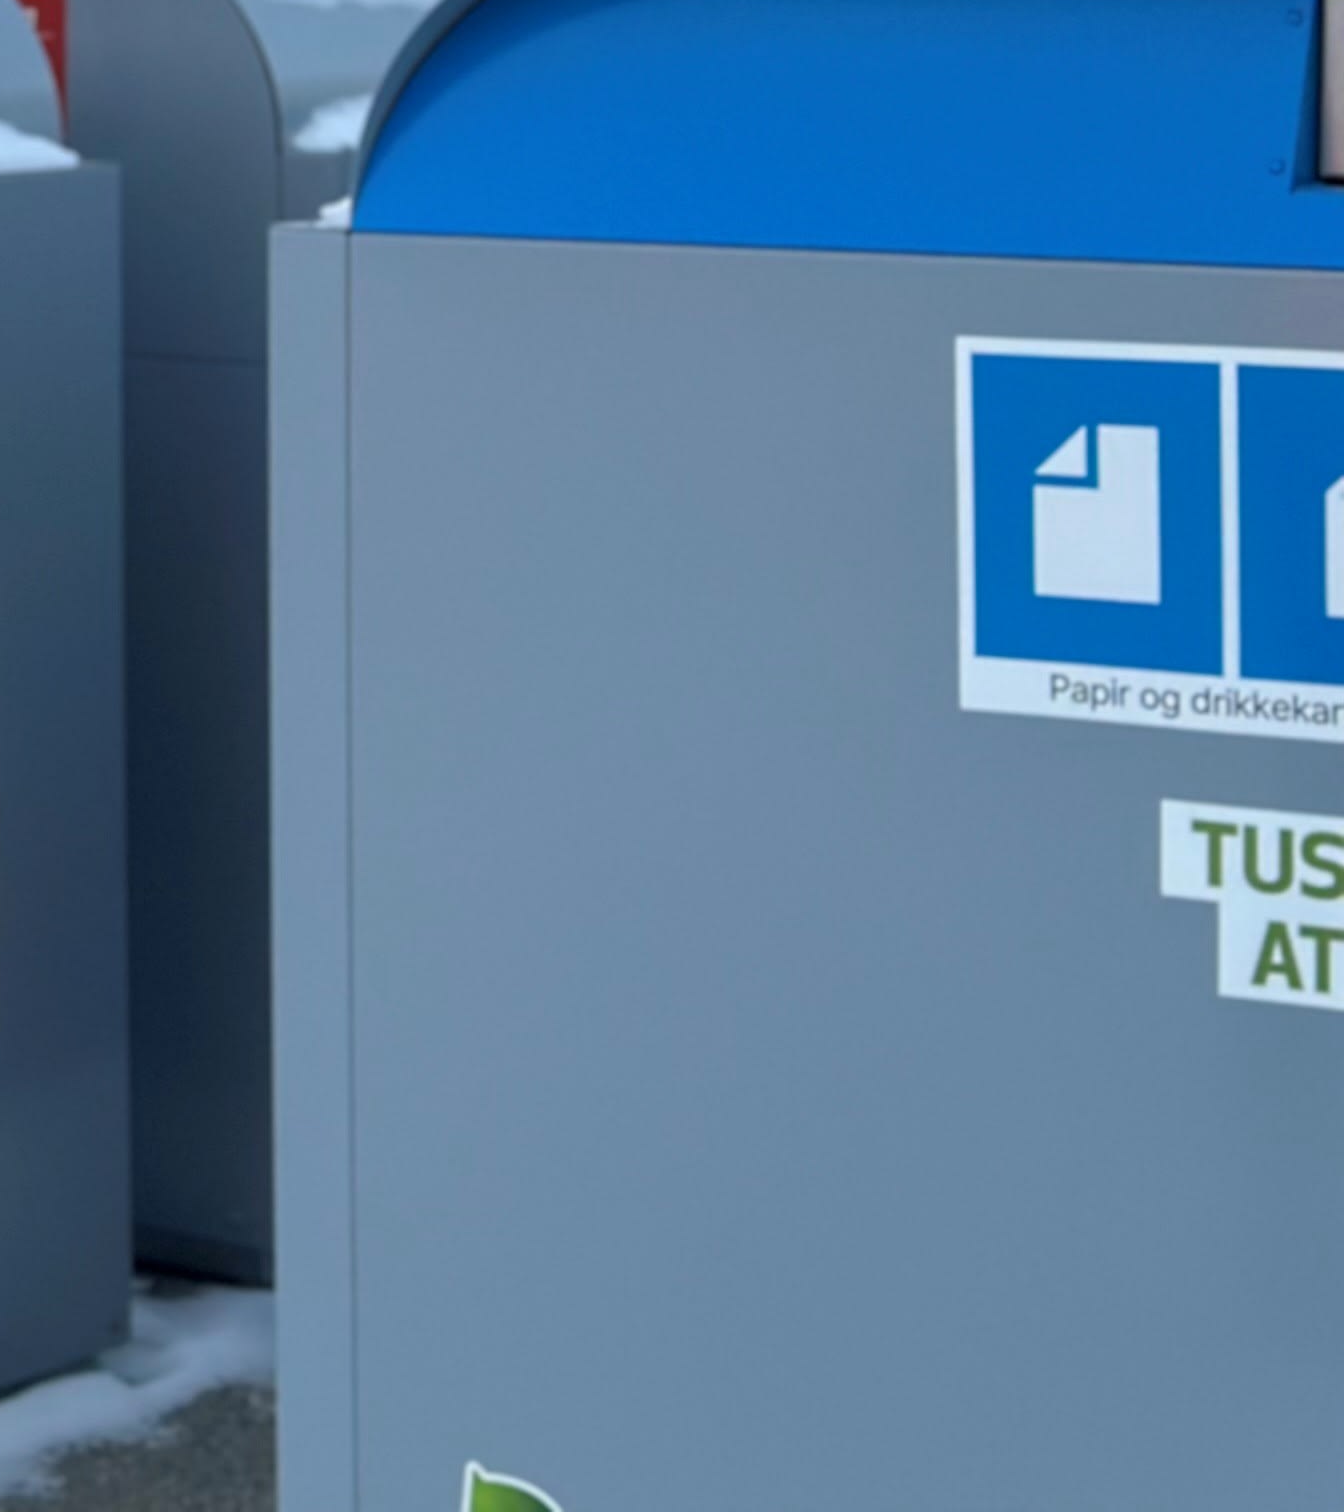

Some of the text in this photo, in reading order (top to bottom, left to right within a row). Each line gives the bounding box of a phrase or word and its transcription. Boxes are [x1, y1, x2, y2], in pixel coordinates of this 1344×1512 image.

[1049, 673, 1131, 711] Papir
[1139, 686, 1182, 720] og
[1191, 818, 1344, 901] TUS
[1251, 919, 1344, 994] AT
